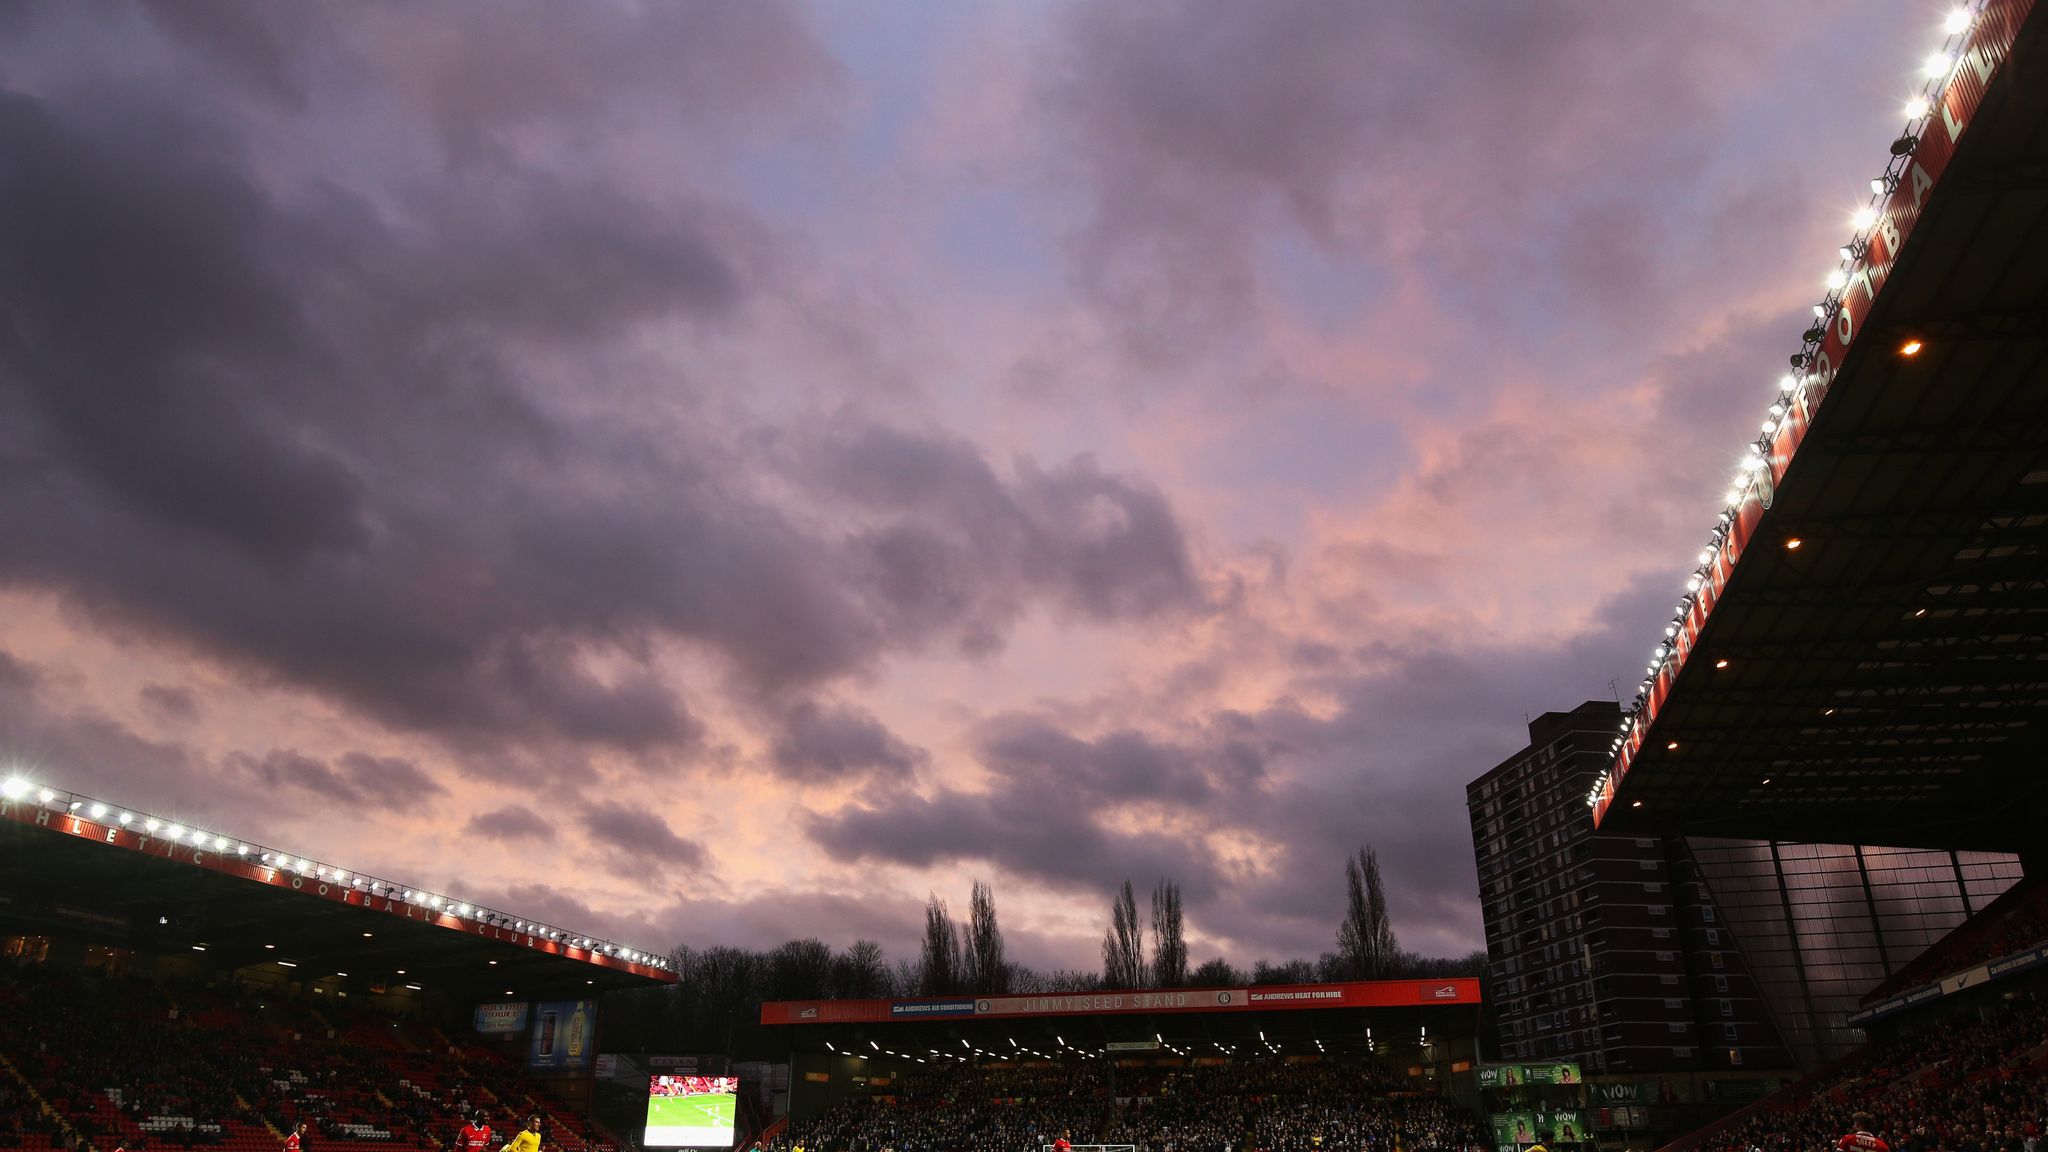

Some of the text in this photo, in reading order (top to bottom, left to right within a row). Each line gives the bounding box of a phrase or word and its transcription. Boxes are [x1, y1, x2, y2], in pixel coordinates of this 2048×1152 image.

[1799, 42, 1996, 423] FOOTBALL
[266, 869, 431, 922] FOOTBALL
[478, 924, 535, 947] CLUB
[1264, 992, 1294, 1000] ANDREWS
[1312, 991, 1326, 999] FOR
[1326, 990, 1342, 998] HIRE
[904, 1004, 931, 1012] ANDREWS
[940, 1003, 974, 1011] CONDITIONING
[1022, 994, 1186, 1012] JIMMY SEED STAND
[1480, 1069, 1498, 1080] WOW
[1554, 1112, 1576, 1122] WOW
